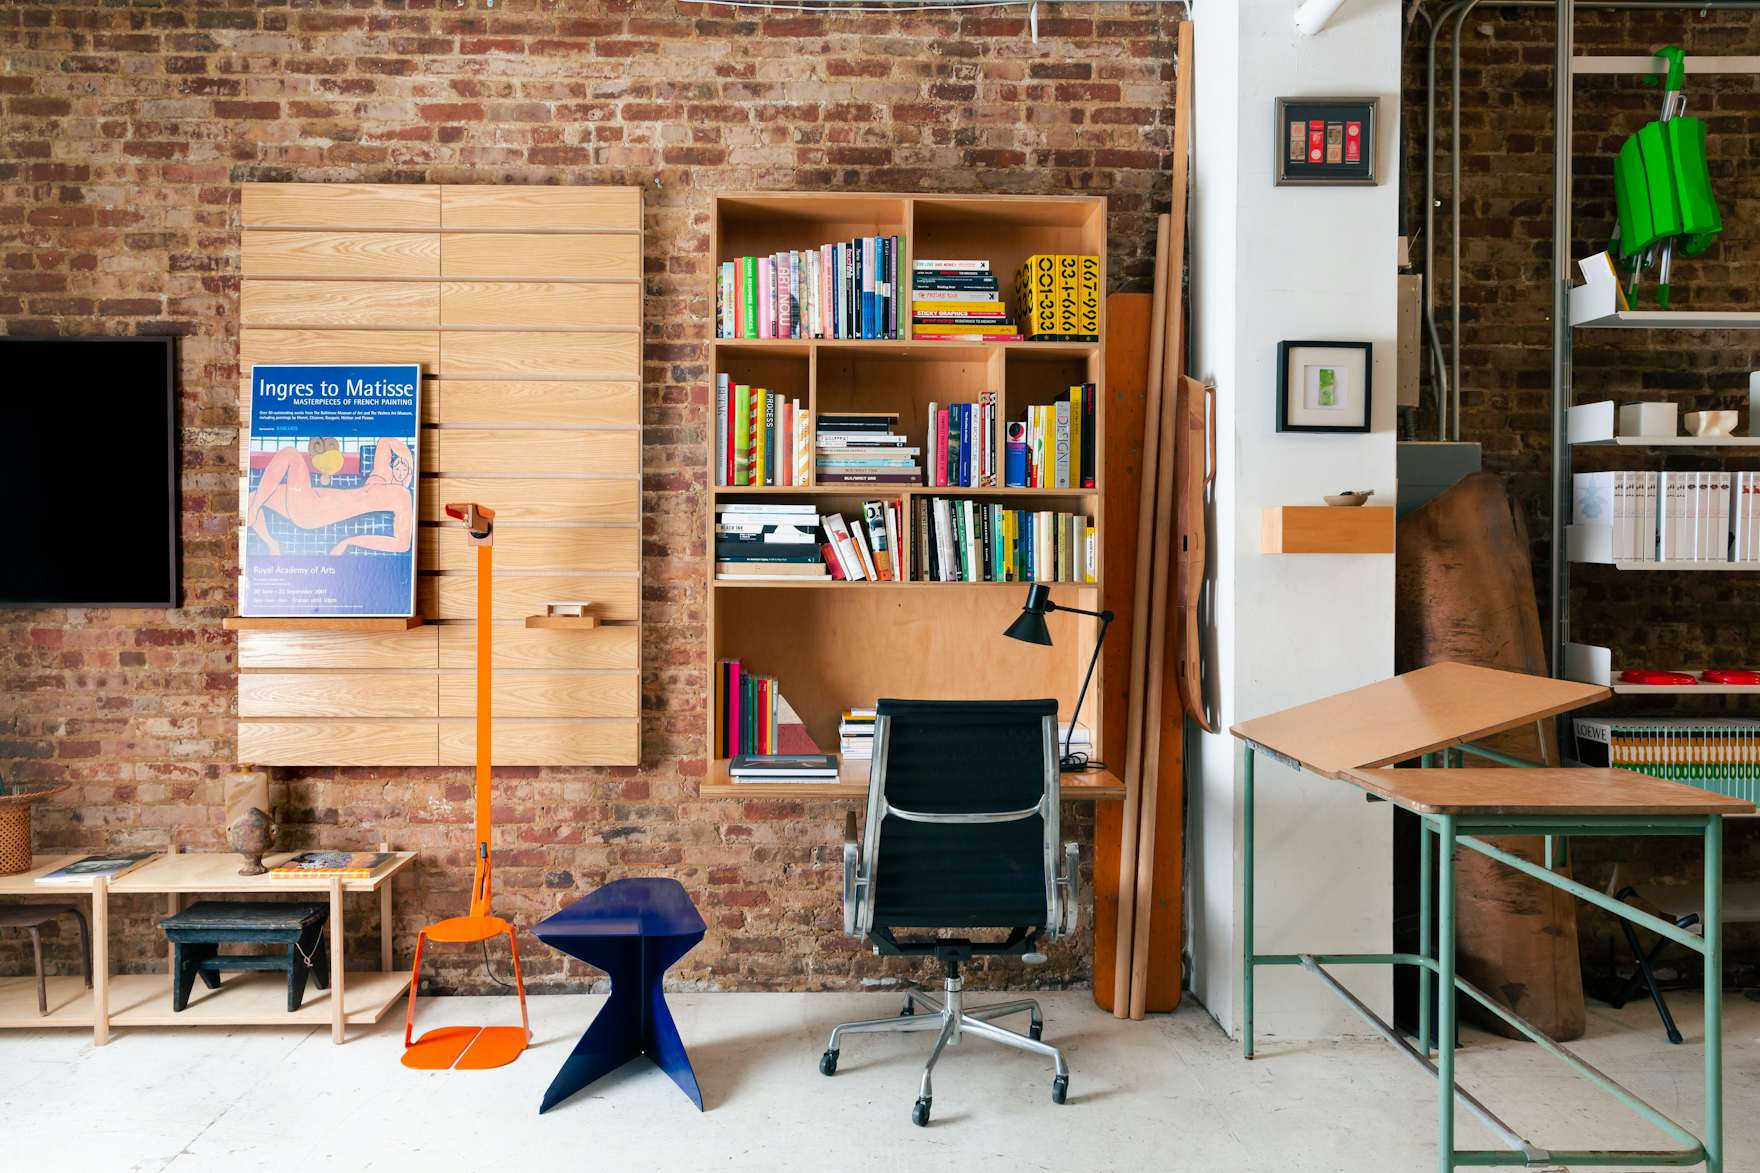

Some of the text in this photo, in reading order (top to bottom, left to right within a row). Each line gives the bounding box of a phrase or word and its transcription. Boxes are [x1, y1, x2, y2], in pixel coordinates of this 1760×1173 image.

[778, 267, 790, 326] ART NOW
[260, 379, 414, 400] Ingres to Matisse
[1057, 416, 1069, 462] DESIGN
[1577, 724, 1607, 741] LOEWE
